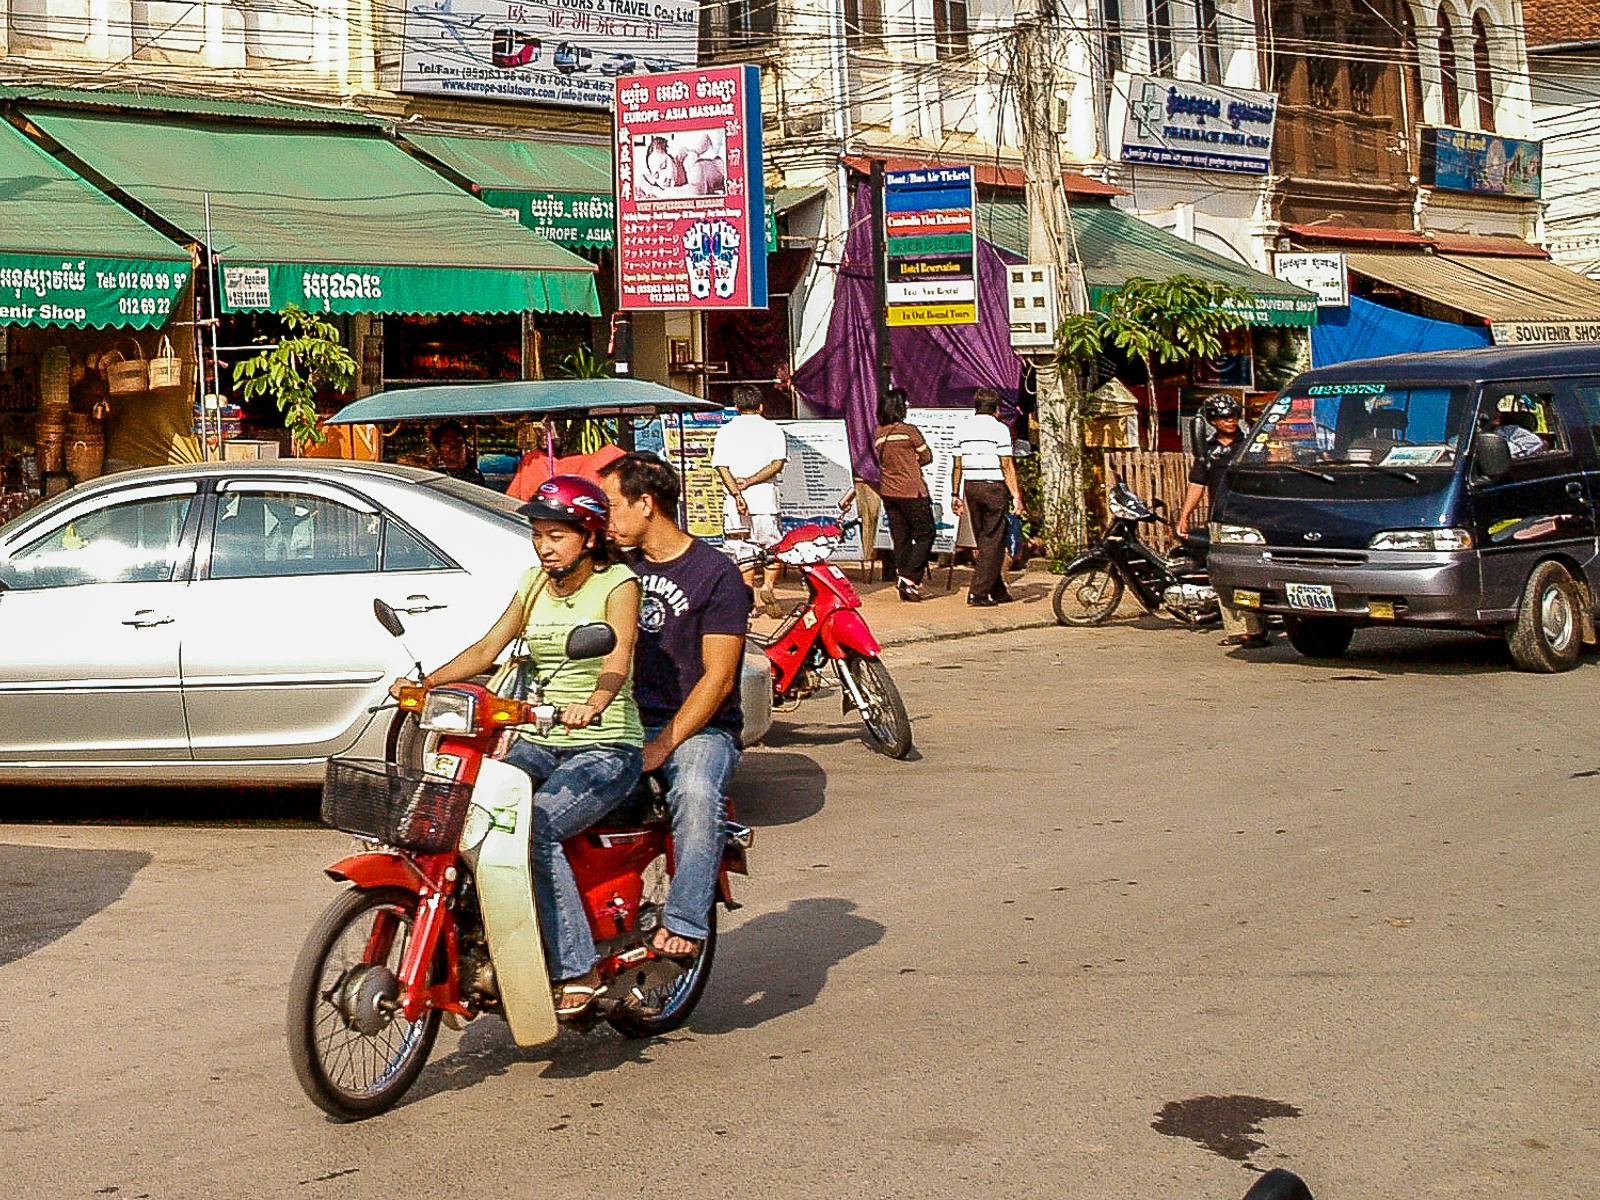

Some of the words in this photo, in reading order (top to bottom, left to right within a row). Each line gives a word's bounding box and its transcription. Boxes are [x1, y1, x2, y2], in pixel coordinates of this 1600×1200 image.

[623, 110, 659, 124] EUROPE
[665, 108, 687, 120] ASIA
[689, 103, 735, 118] MASSAGE
[534, 226, 578, 241] EUROPE
[586, 228, 612, 241] ASIA
[96, 271, 116, 289] Tel:
[118, 272, 138, 289] 012
[155, 272, 170, 290] 99
[39, 303, 86, 323] Shop
[118, 297, 140, 314] 012
[141, 297, 155, 315] 69
[157, 297, 170, 314] 22
[1516, 325, 1571, 341] SOUVENIR
